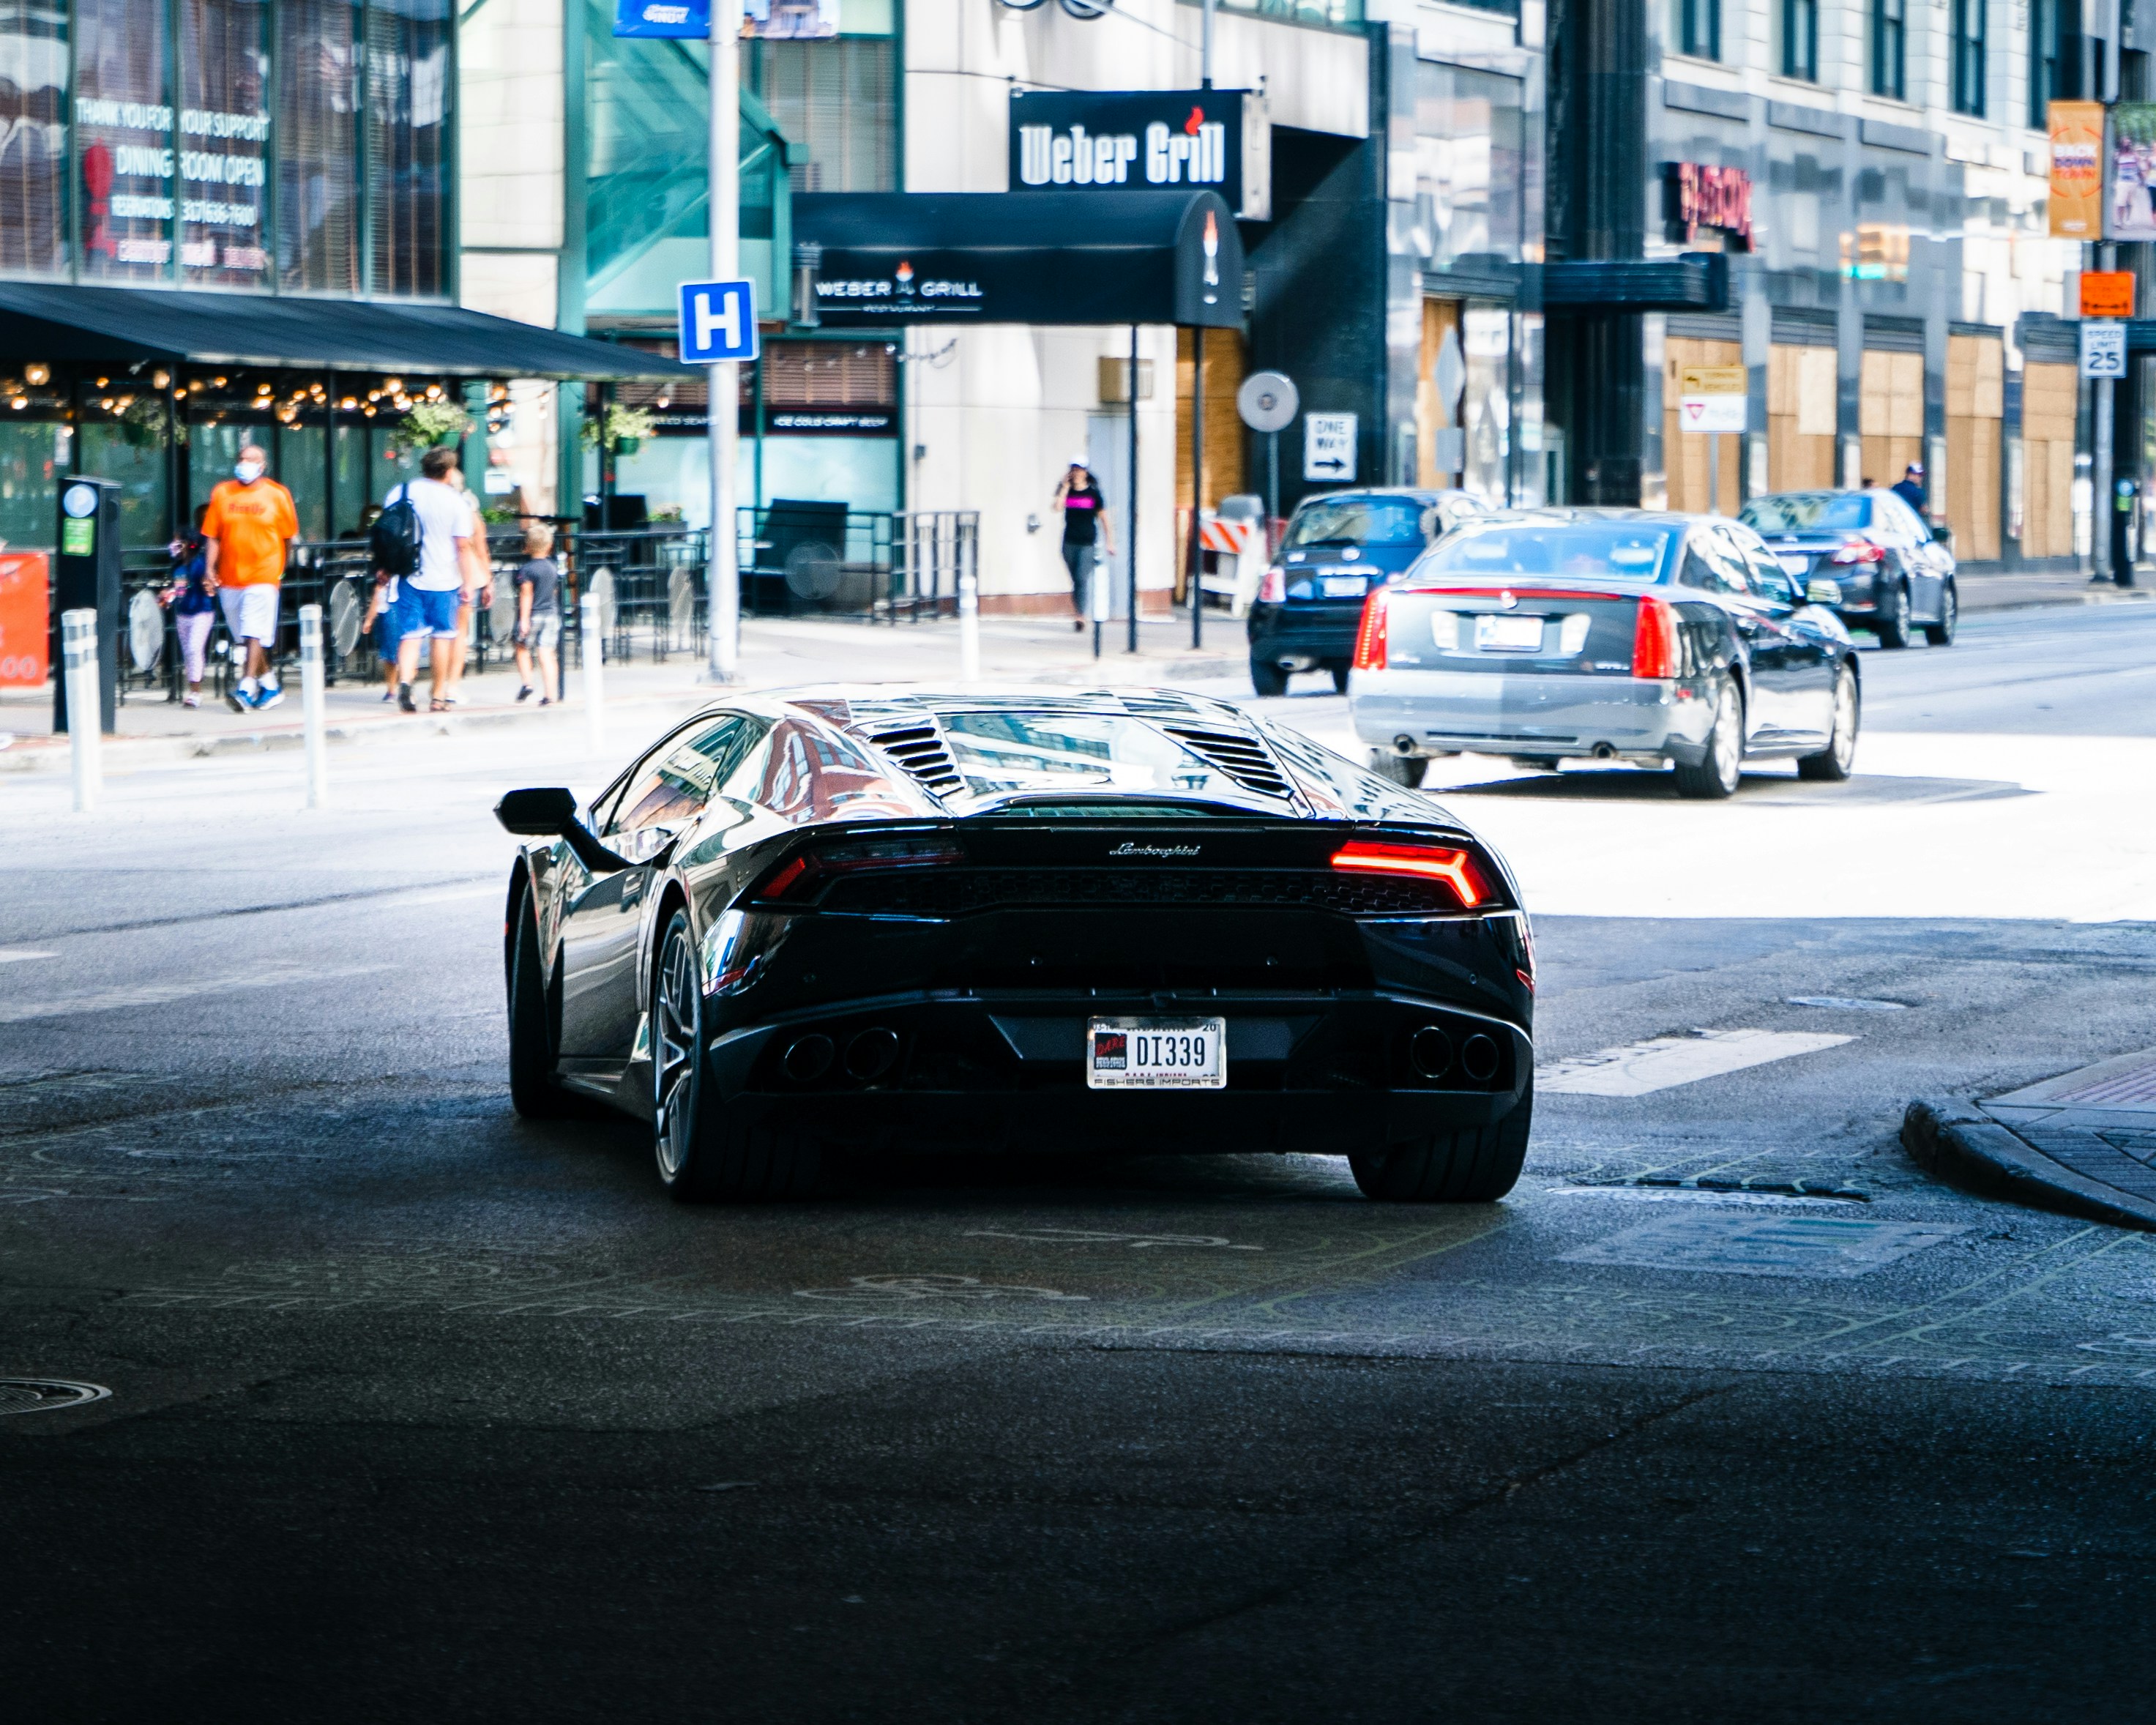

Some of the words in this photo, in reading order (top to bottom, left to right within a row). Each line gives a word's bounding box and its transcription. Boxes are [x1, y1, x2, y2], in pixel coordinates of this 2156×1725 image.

[75, 97, 121, 126] THANK
[213, 111, 271, 141] SUPPORT
[1018, 123, 1138, 185] Weber
[1145, 119, 1225, 184] Grill
[2054, 144, 2097, 157] BACK
[116, 144, 176, 178] DINING
[224, 155, 266, 187] OPEN
[2054, 157, 2096, 168] DOWN
[815, 281, 892, 297] WEBER
[920, 281, 983, 297] GRILL
[694, 291, 742, 351] H
[2087, 330, 2122, 339] SPEED
[2091, 341, 2118, 350] LIMIT
[2089, 351, 2120, 370] 25
[774, 416, 794, 427] ICE
[1315, 420, 1347, 435] ONE
[1317, 437, 1348, 450] WAY
[1109, 842, 1201, 858] Lamborghini
[1137, 1036, 1205, 1067] DI339
